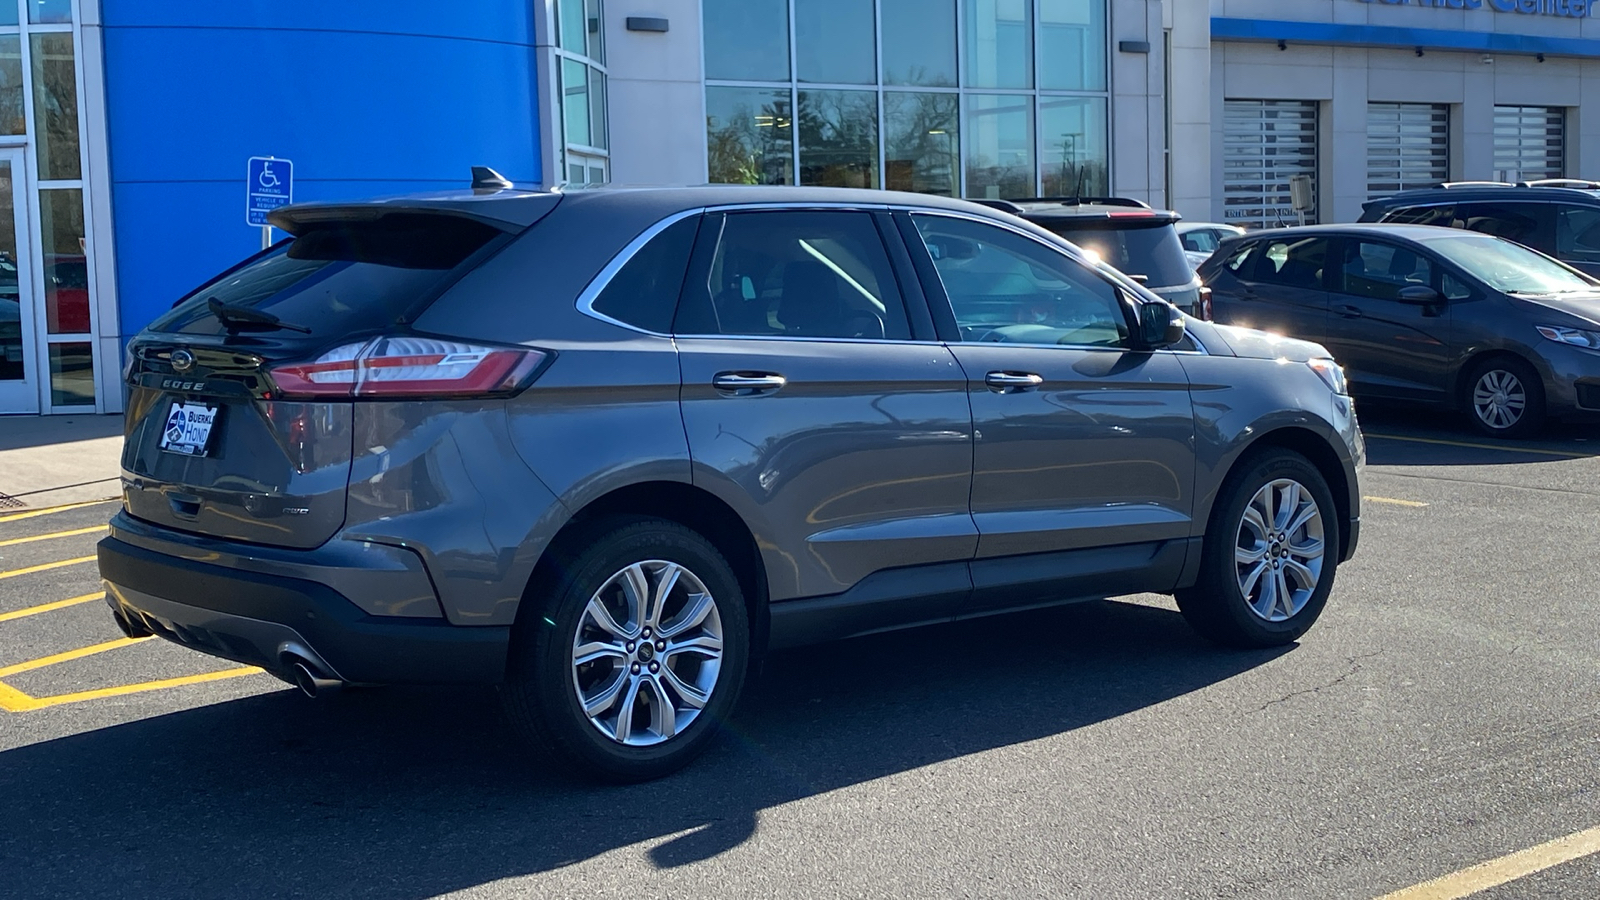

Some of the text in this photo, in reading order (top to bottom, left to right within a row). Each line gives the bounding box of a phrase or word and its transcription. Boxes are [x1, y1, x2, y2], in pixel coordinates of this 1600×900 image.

[163, 379, 205, 390] EDGE
[188, 411, 212, 425] BUERKL
[185, 423, 208, 443] HOND
